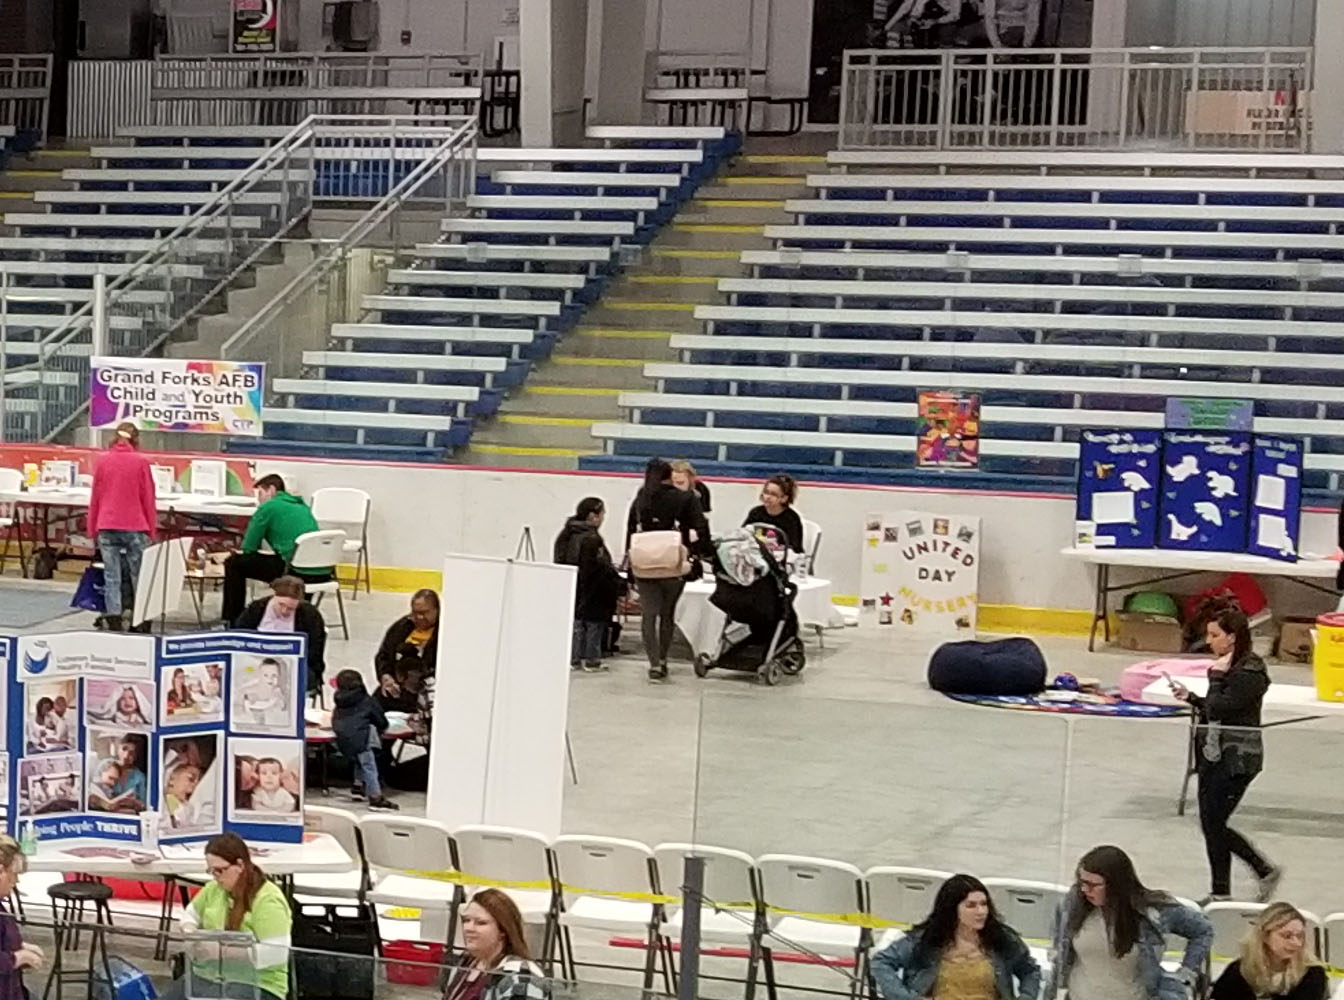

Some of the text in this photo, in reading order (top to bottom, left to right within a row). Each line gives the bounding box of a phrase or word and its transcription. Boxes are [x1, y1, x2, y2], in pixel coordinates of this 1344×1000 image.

[99, 368, 256, 388] Grand Forks AFB
[110, 386, 244, 405] Child and Youth
[132, 404, 220, 423] Programs
[902, 539, 974, 567] UNITED
[918, 567, 956, 582] DAY
[60, 821, 95, 834] People
[95, 820, 137, 836] THRIVE
